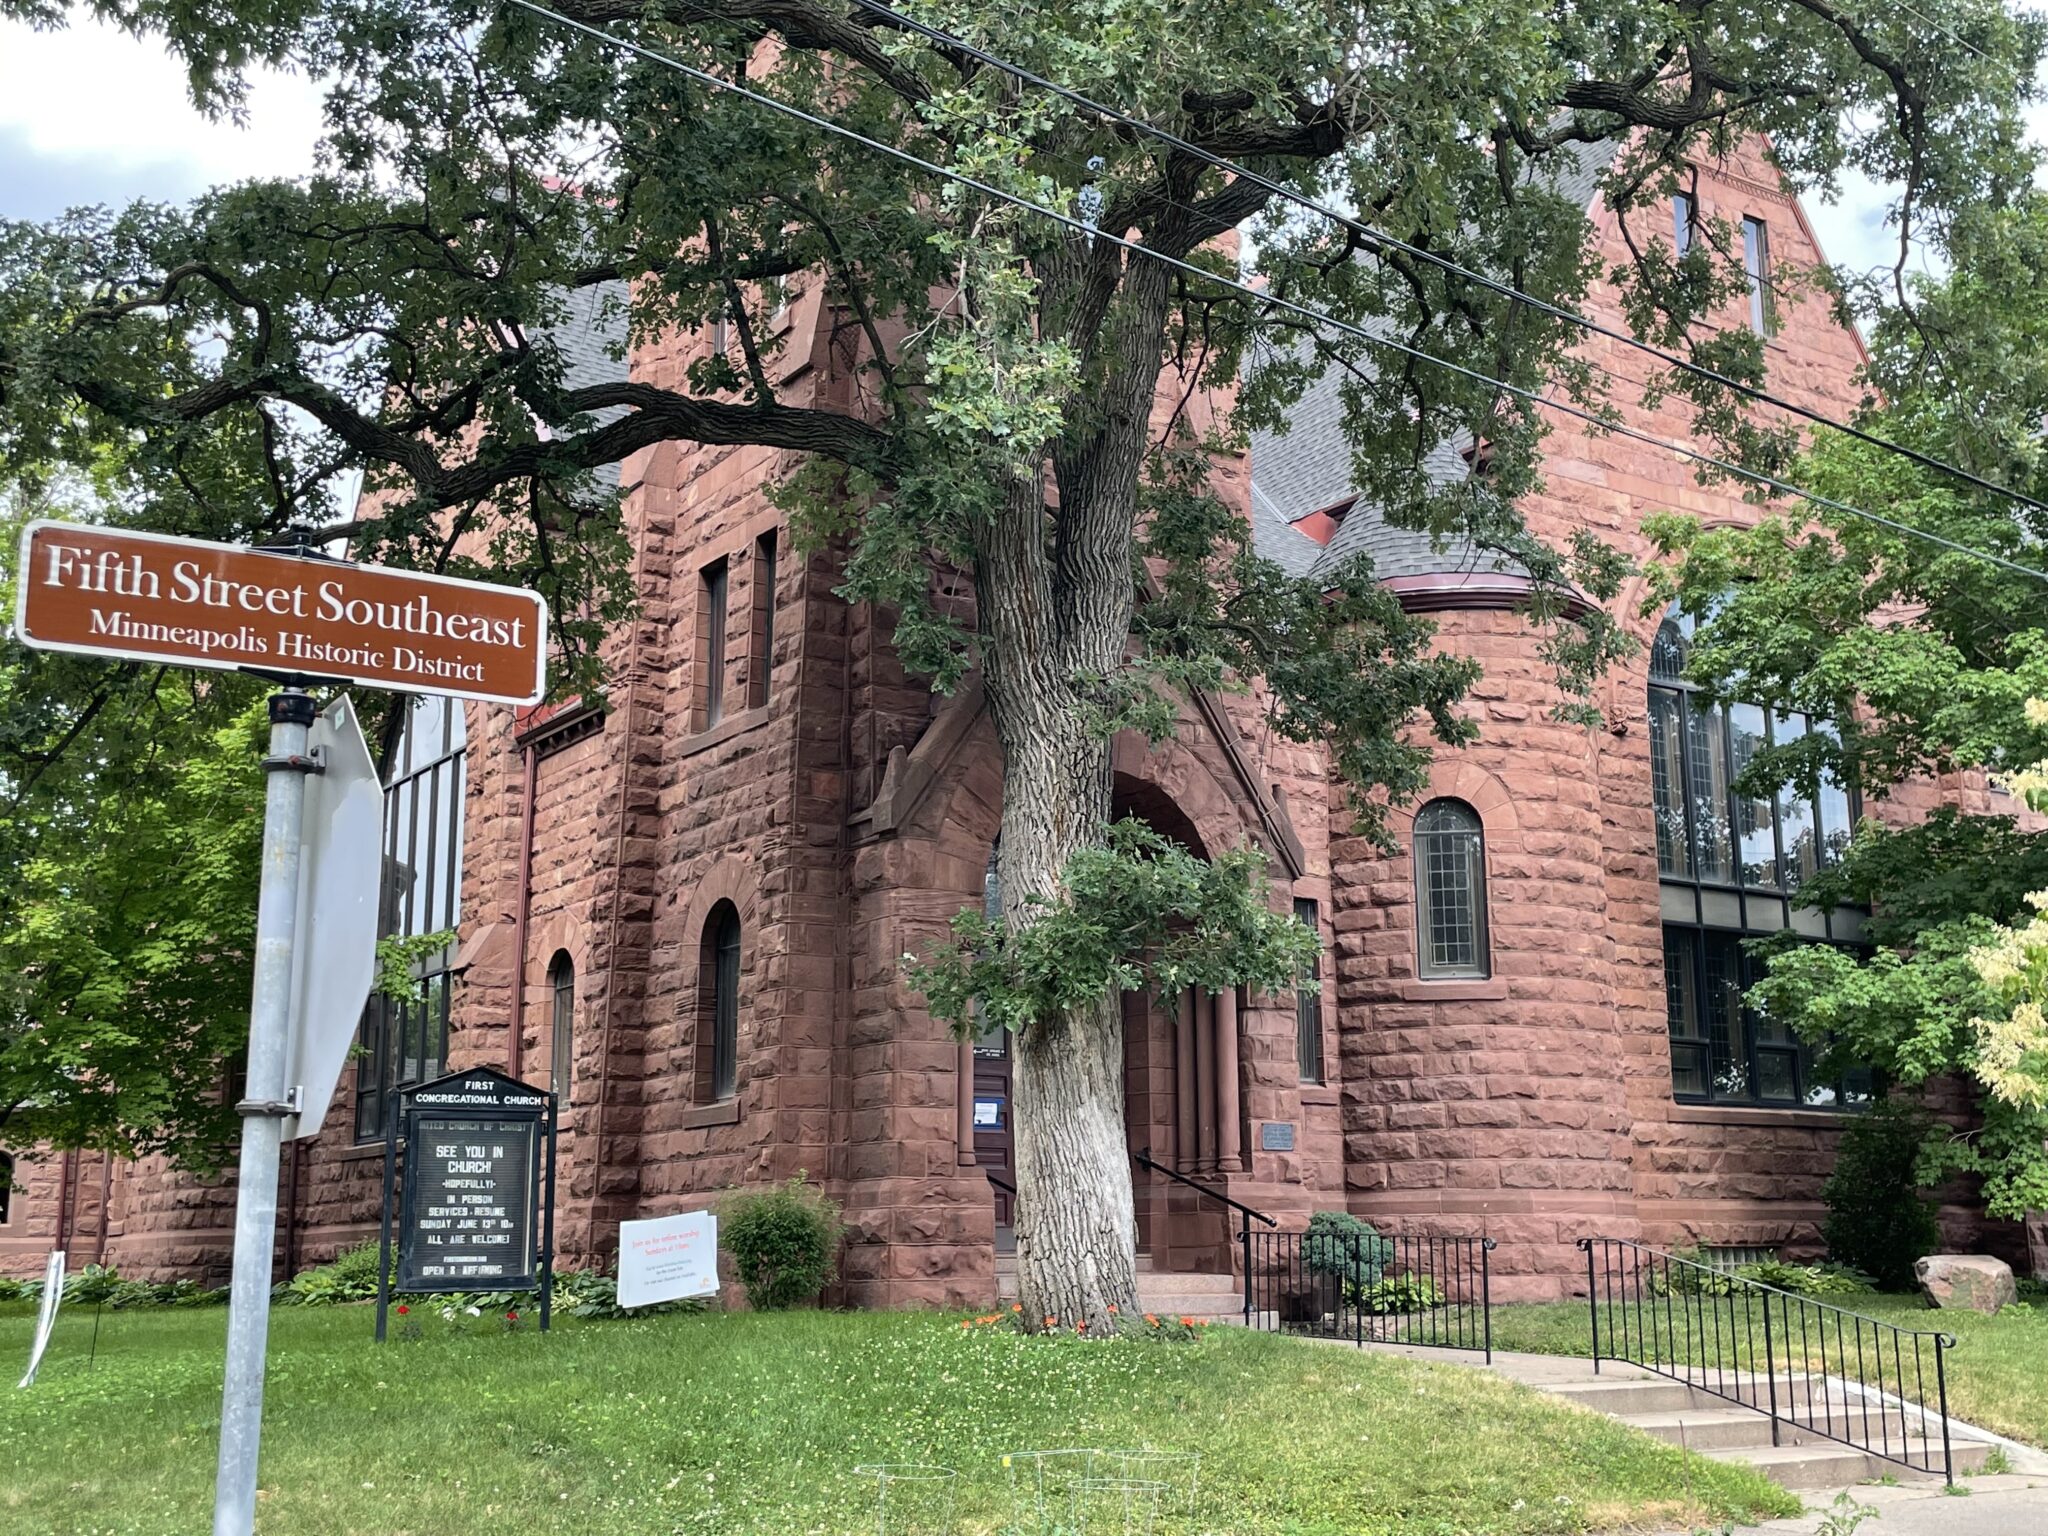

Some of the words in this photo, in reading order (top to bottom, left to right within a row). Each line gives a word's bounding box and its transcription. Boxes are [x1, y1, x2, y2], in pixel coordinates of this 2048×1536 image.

[43, 543, 161, 600] Fifth
[170, 560, 308, 618] Street
[316, 581, 527, 649] Southeast
[90, 609, 268, 654] Minneapolis
[277, 632, 384, 668] Historic
[392, 647, 486, 683] District
[465, 1081, 495, 1091] FIRST
[415, 1093, 500, 1105] CONGREGATIONAL
[503, 1096, 542, 1106] CHURCH
[436, 1145, 458, 1158] SEE
[464, 1145, 486, 1158] YOU
[493, 1146, 504, 1159] IN
[448, 1161, 492, 1174] CHURCH!
[446, 1194, 456, 1204] IN
[461, 1194, 494, 1204] PERSON
[474, 1207, 506, 1217] RESUME
[420, 1219, 452, 1229] SUNDAY
[456, 1219, 479, 1229] JUNE
[427, 1234, 443, 1245] ALL
[449, 1234, 466, 1244] ARE
[422, 1265, 445, 1276] OPEN
